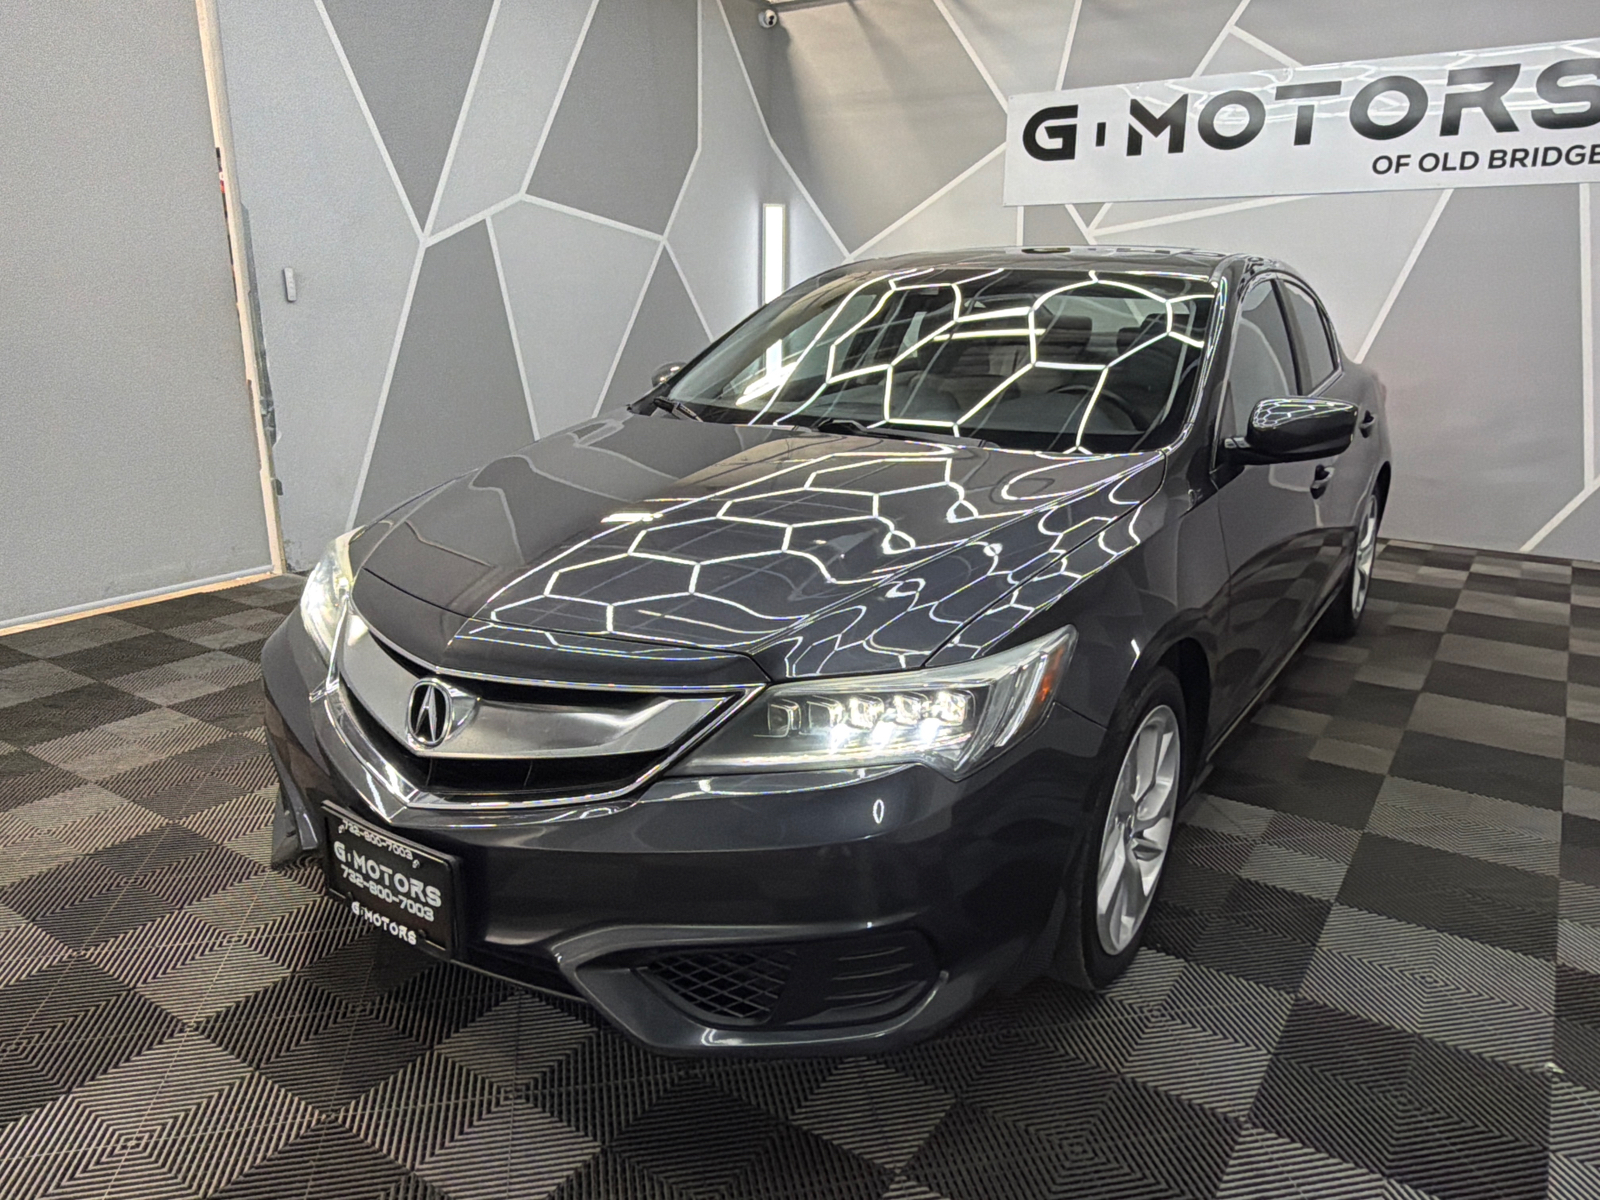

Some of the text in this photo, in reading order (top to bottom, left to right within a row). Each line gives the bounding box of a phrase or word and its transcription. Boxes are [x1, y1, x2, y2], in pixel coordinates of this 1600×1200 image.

[1372, 144, 1600, 175] OF OLD BRIDGE
[340, 864, 435, 922] 732-800-7003
